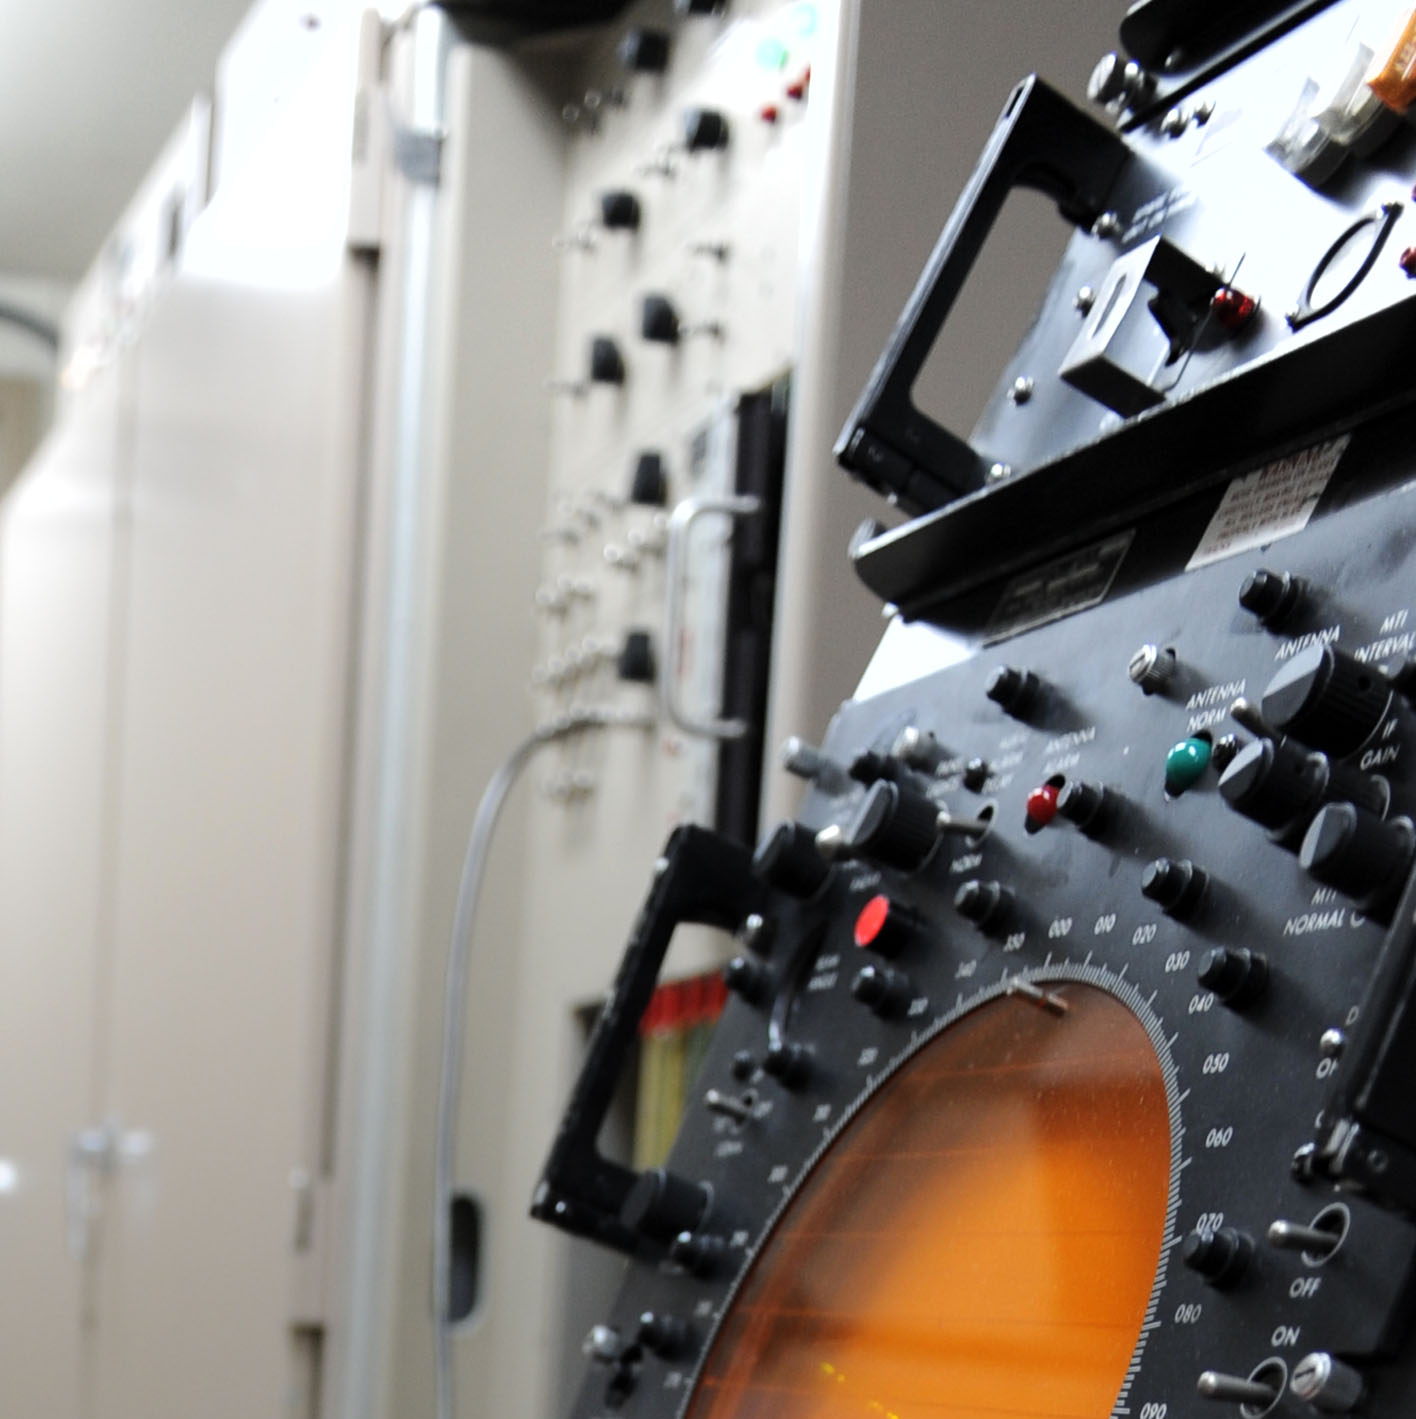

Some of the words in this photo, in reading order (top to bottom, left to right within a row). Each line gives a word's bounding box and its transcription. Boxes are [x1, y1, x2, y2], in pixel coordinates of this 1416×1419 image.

[1379, 608, 1409, 635] MTI
[1274, 624, 1341, 661] ANTENNA
[1185, 678, 1247, 711] ANTENNA
[1186, 707, 1226, 732] NORM
[1360, 744, 1401, 771] GAIN
[1048, 917, 1073, 939] 000
[1094, 913, 1117, 935] 010
[1283, 908, 1346, 936] NORMAL
[1132, 923, 1157, 946] 020
[1164, 951, 1190, 973] 030
[1188, 993, 1214, 1015] 040
[1202, 1052, 1230, 1075] 050
[1205, 1126, 1233, 1148] 060
[1196, 1212, 1224, 1234] 070
[1289, 1277, 1321, 1299] OFF
[1174, 1304, 1202, 1325] 080
[1271, 1325, 1301, 1347] ON
